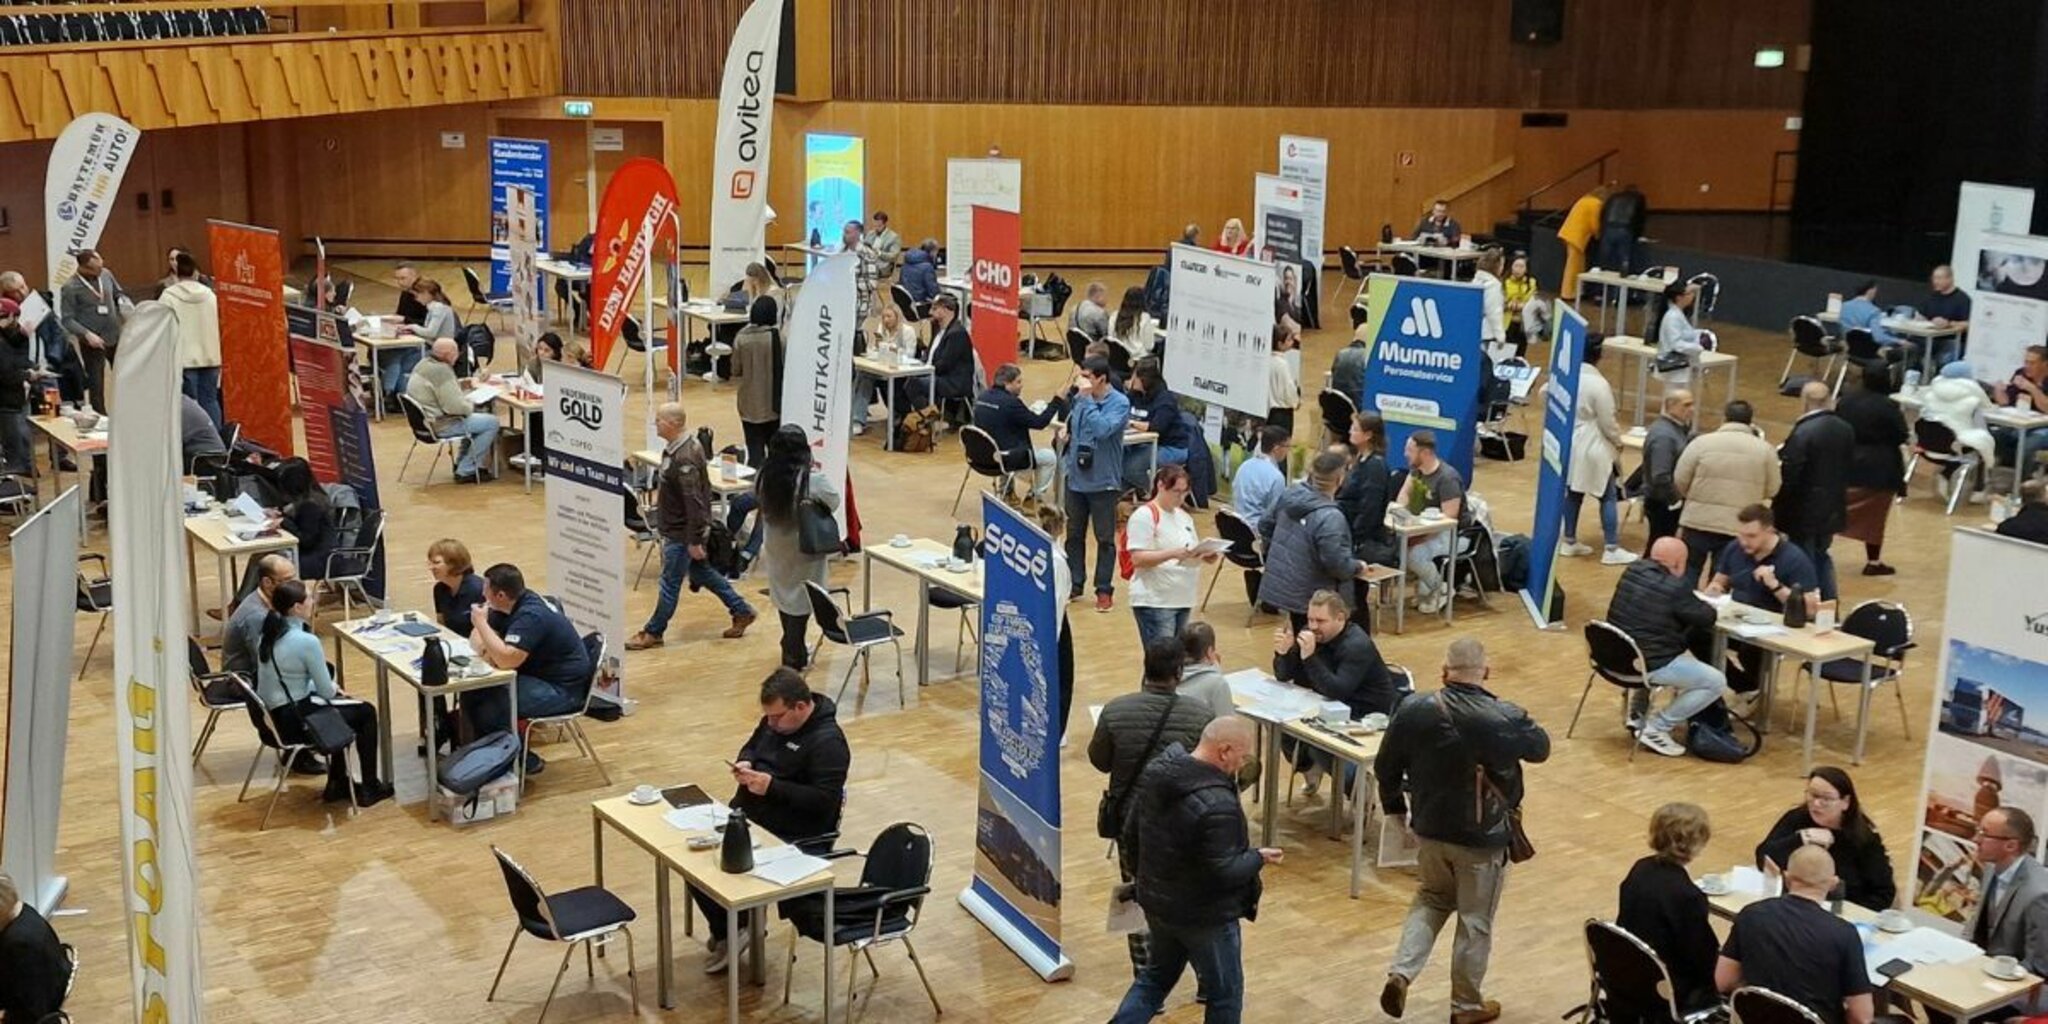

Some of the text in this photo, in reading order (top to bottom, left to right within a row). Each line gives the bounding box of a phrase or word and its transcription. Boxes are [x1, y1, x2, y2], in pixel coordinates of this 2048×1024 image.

[737, 50, 764, 162] avitea
[66, 201, 98, 257] KAUFEN
[91, 174, 110, 199] IHR
[103, 128, 130, 173] AUTO!
[976, 259, 1011, 288] CHO
[599, 284, 624, 332] DEN
[813, 304, 833, 432] HEITKAMP
[1379, 341, 1462, 370] Mumme
[560, 397, 603, 424] GOLD
[560, 460, 574, 472] sind
[575, 464, 586, 476] ein
[587, 466, 606, 482] Team
[985, 522, 1047, 591] sesé
[2024, 614, 2048, 637] Yu
